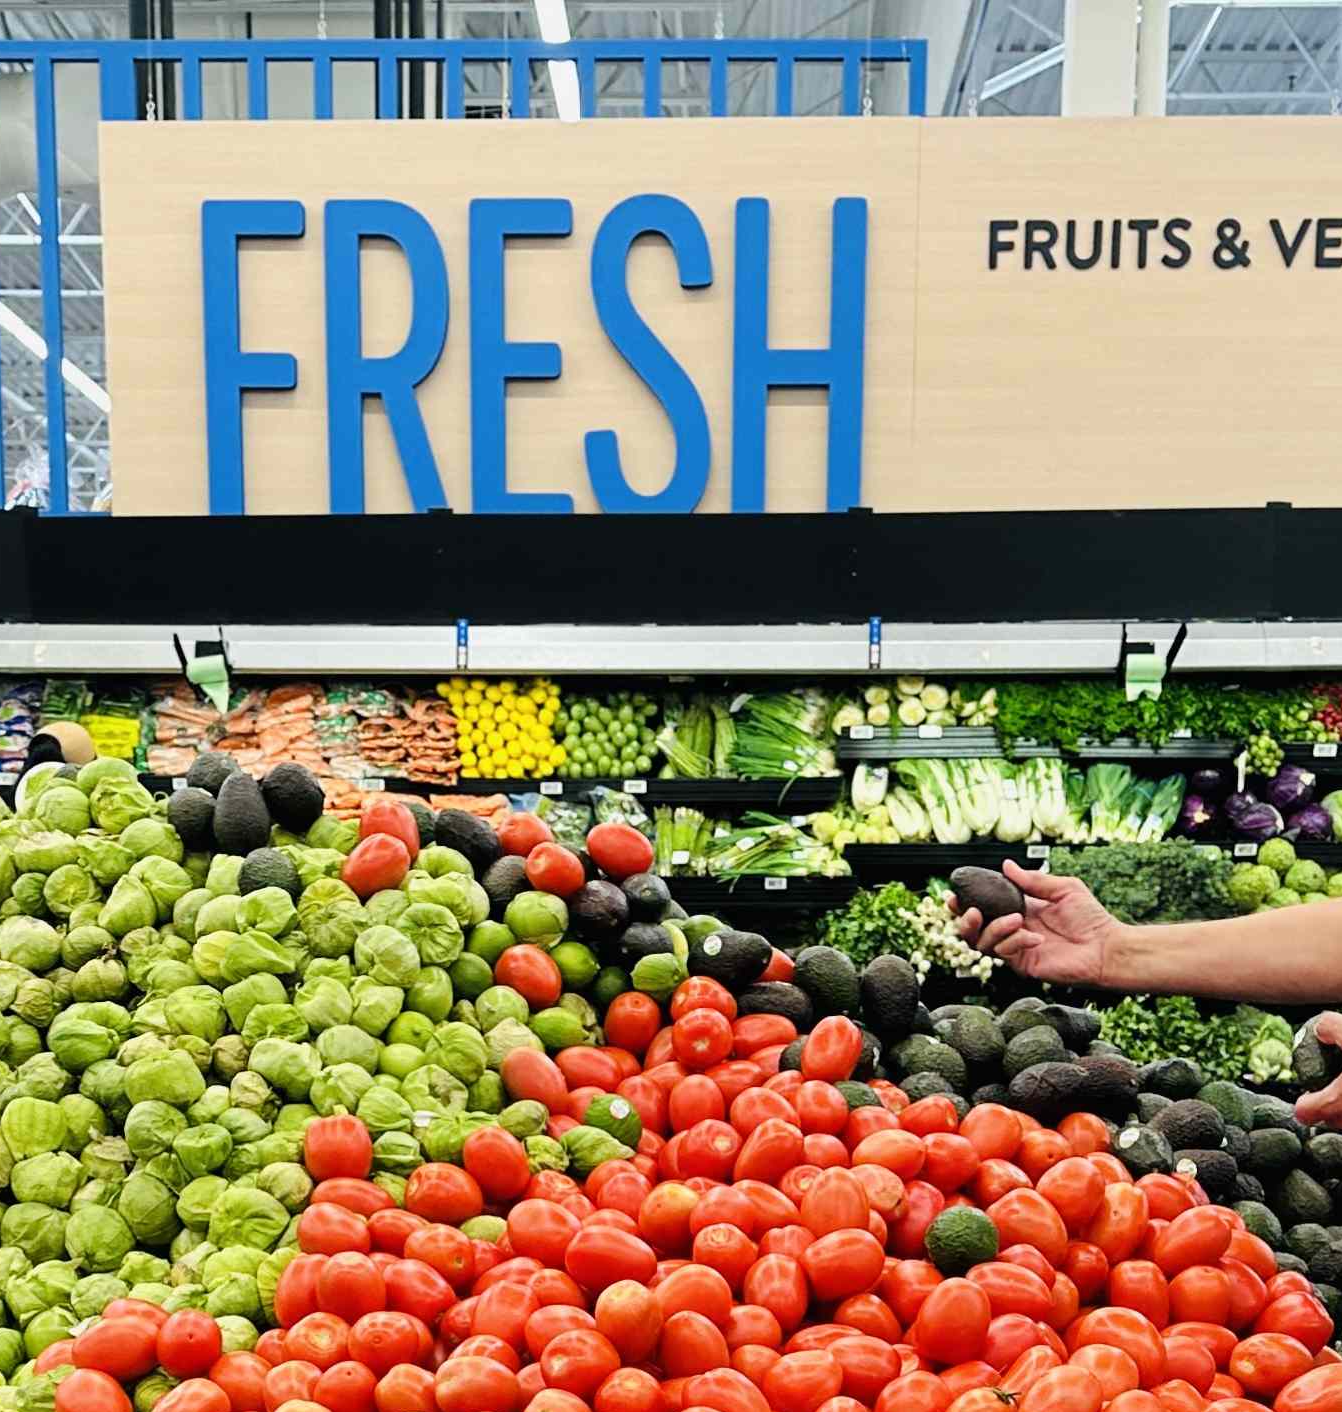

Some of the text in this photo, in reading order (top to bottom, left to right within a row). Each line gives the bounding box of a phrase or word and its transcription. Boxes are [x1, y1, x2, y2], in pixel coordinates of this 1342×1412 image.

[988, 218, 1192, 270] FRUITS
[1212, 217, 1252, 270] &
[201, 193, 868, 514] FRESH
